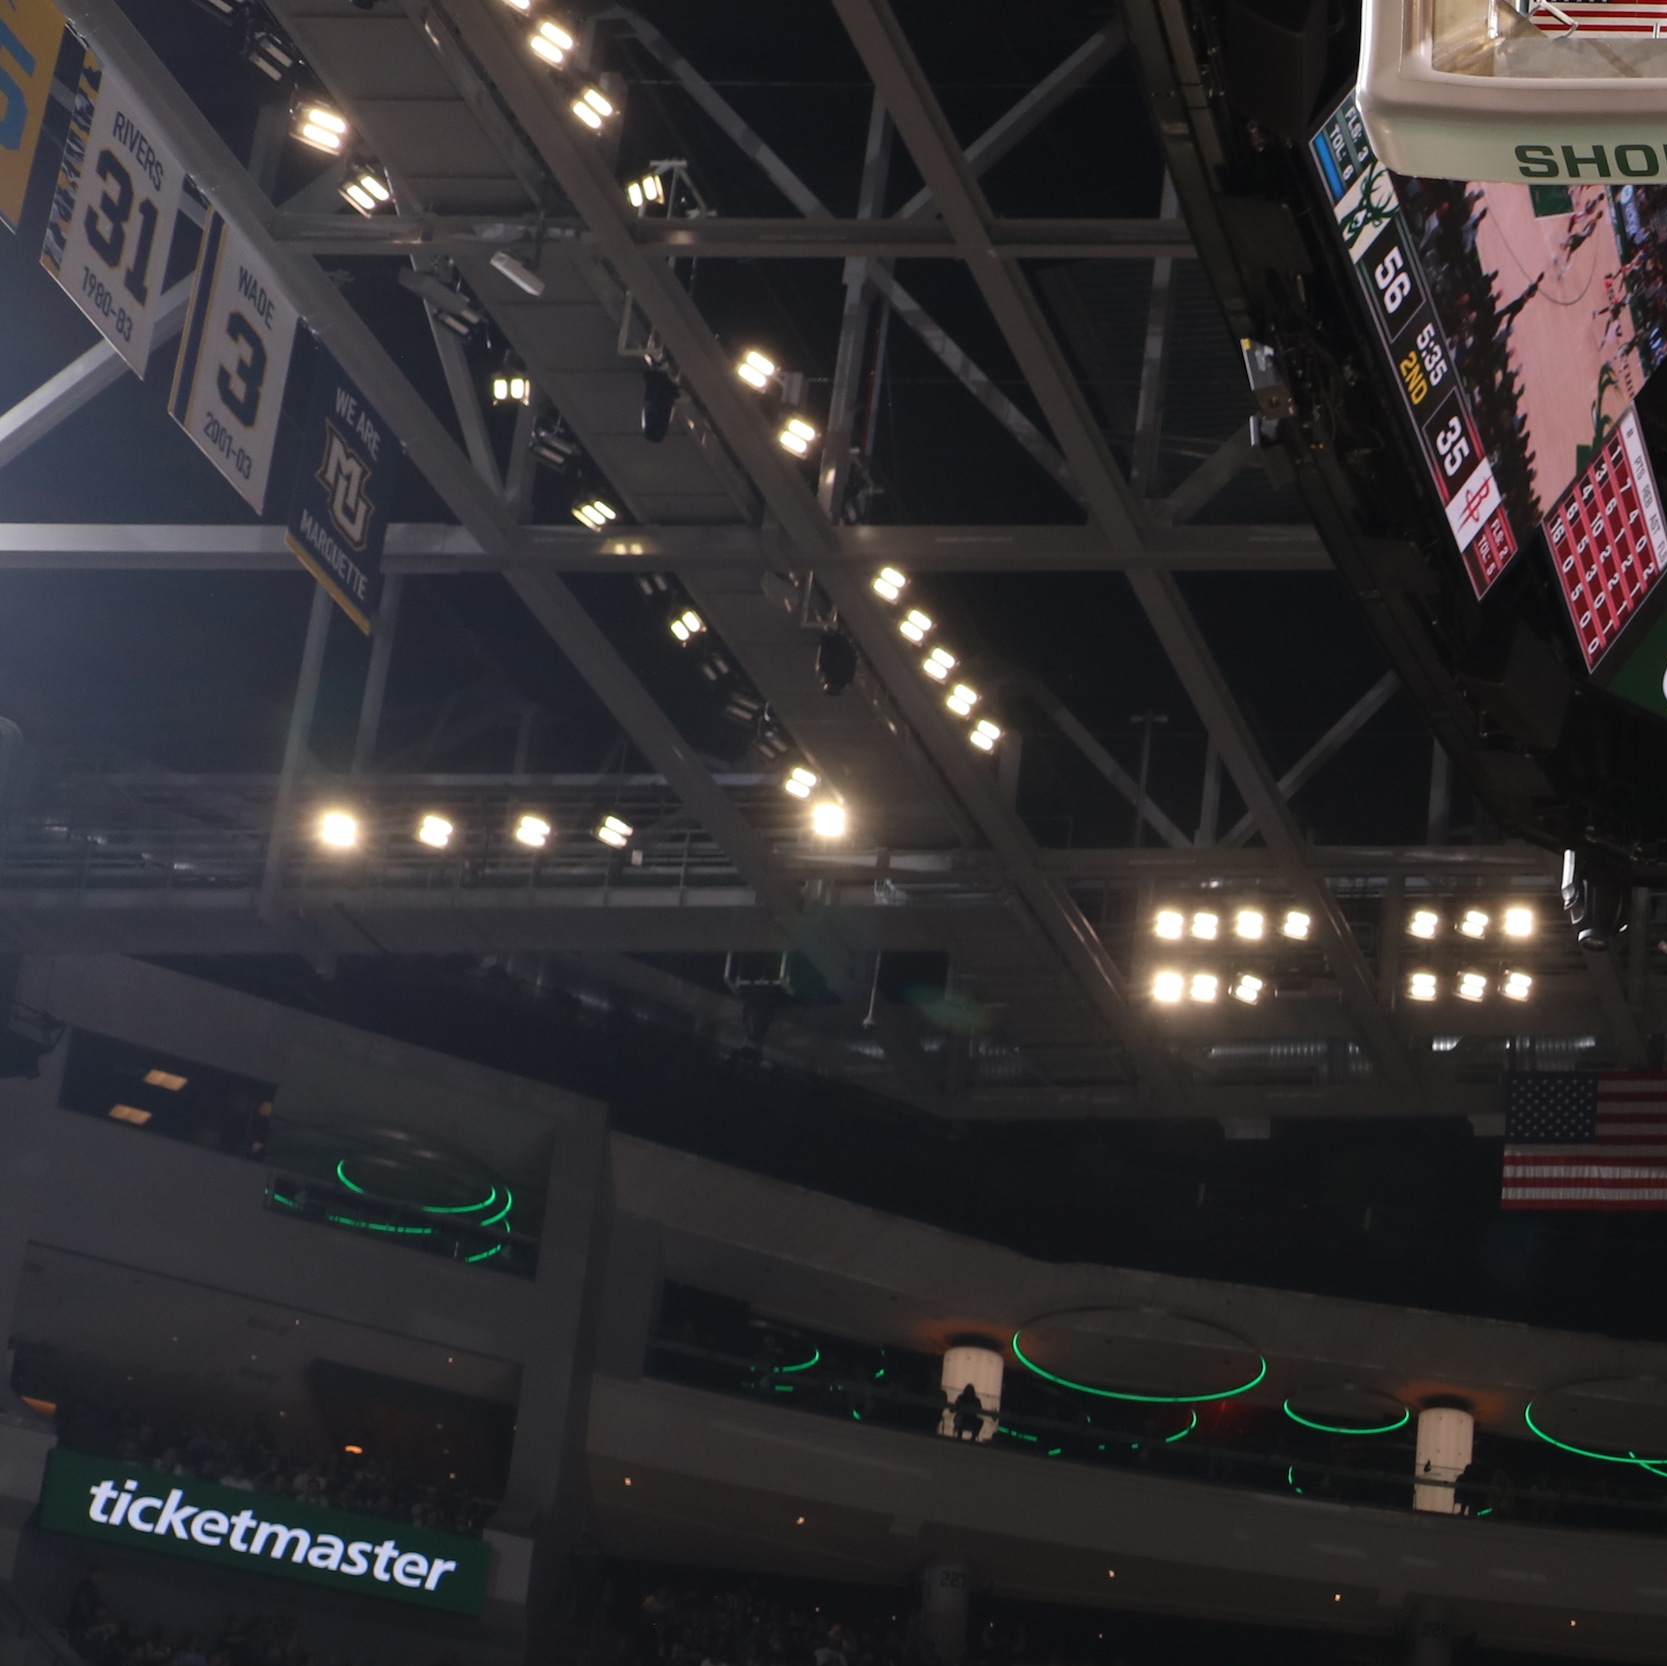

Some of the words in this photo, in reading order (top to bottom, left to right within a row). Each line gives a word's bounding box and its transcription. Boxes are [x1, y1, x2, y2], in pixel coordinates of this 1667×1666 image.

[112, 110, 163, 192] RIVERS
[84, 149, 158, 308] 31
[81, 265, 133, 343] 1980-83
[238, 266, 275, 331] WADE
[1374, 246, 1412, 314] 56
[217, 311, 267, 430] 3
[1399, 352, 1428, 405] 2ND
[1416, 322, 1448, 387] 5:35
[204, 412, 252, 480] 2001-03
[336, 387, 356, 420] WE
[356, 413, 381, 462] ARE
[1436, 416, 1470, 477] 35
[300, 508, 367, 601] MARQUETTE
[88, 1478, 457, 1593] ticketmaster
